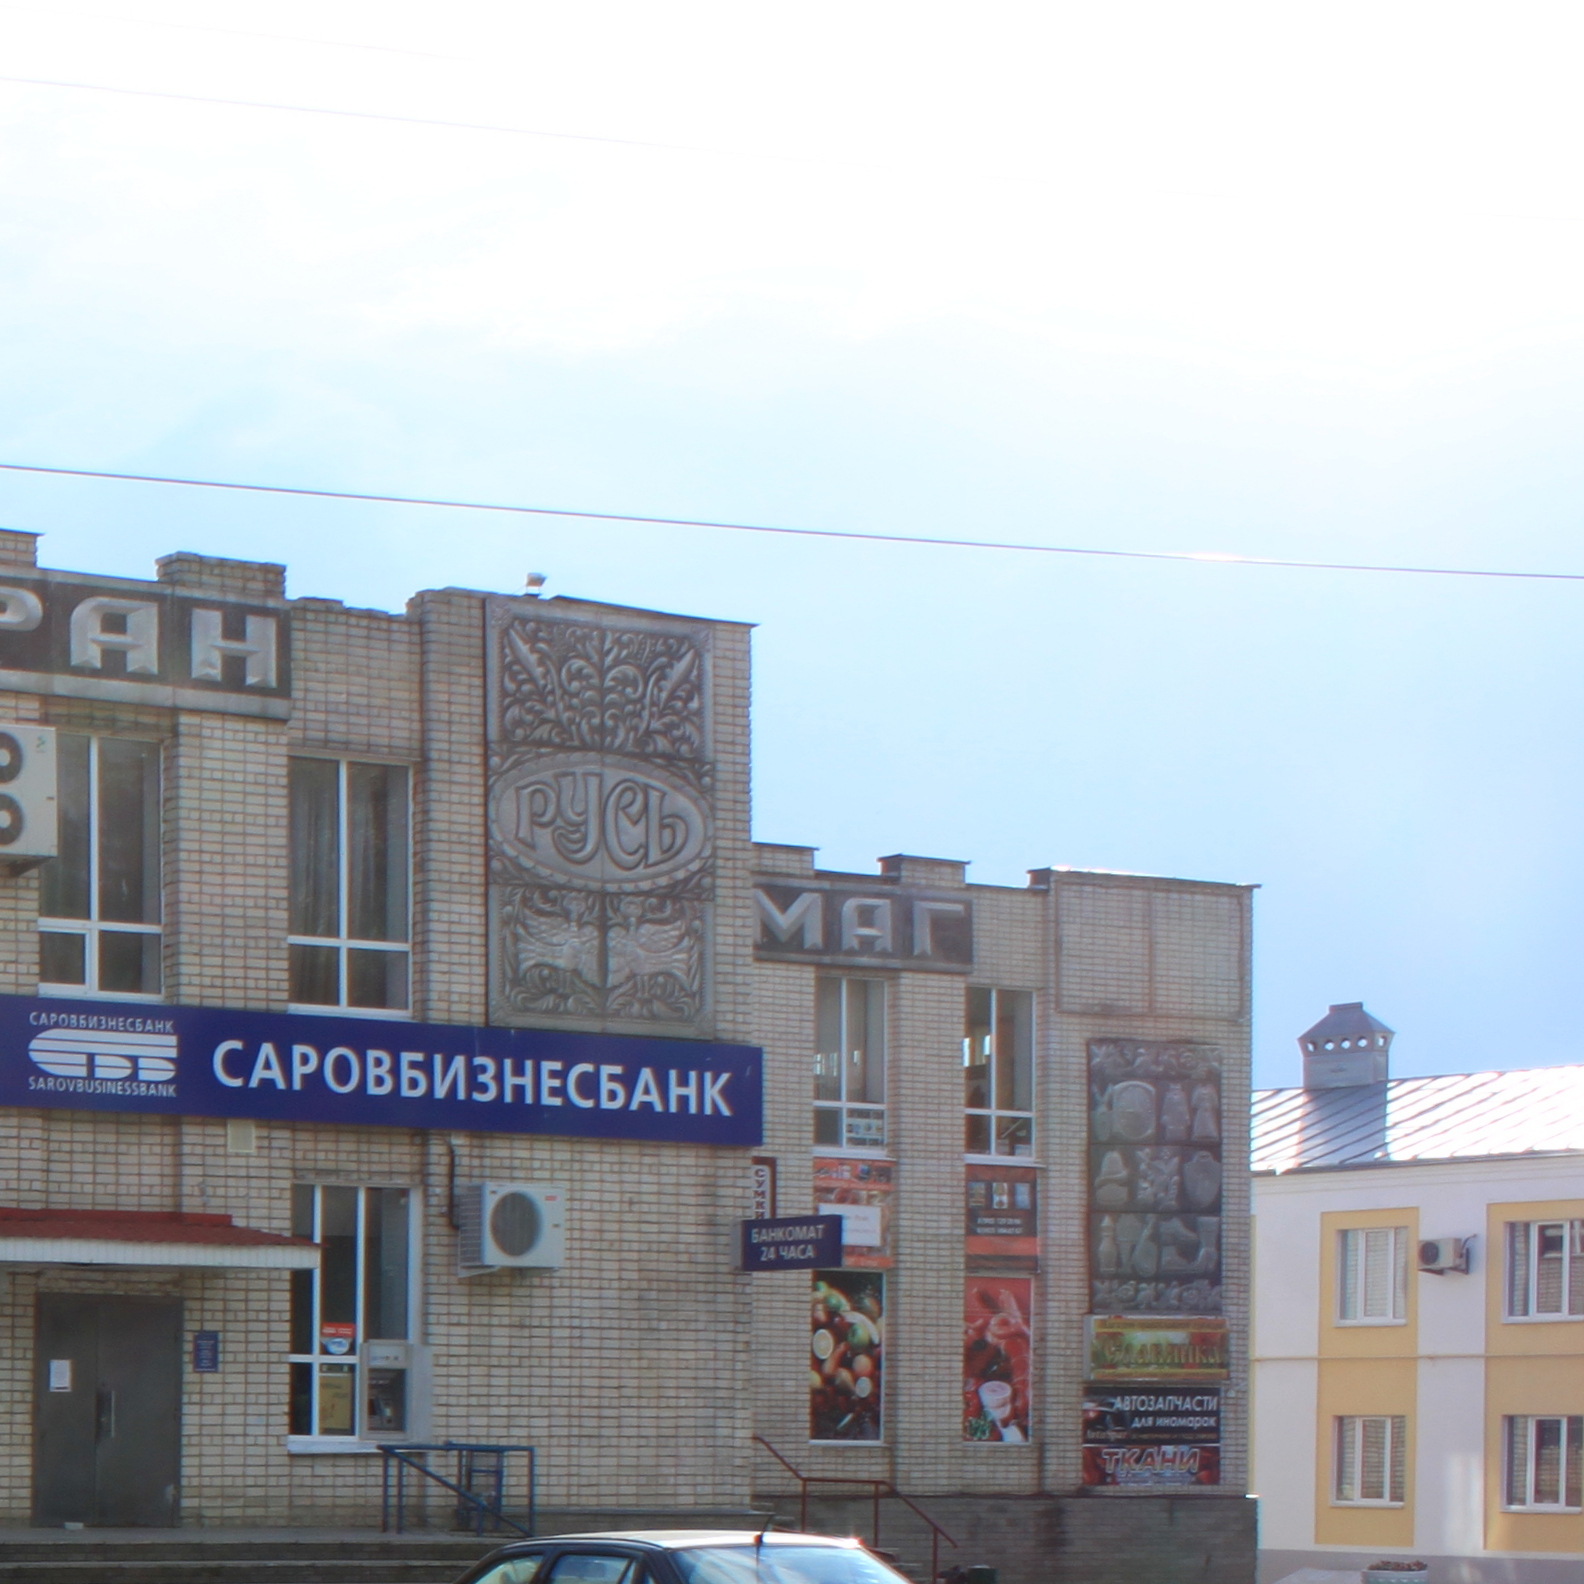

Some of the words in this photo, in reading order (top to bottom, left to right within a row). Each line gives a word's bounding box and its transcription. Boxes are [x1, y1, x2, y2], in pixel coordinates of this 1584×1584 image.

[514, 772, 689, 870] РУСЬ
[29, 1011, 174, 1034] САРОВБИЗНЕСБАНК
[28, 1076, 177, 1098] SAROVBUSINESSBANK
[212, 1039, 734, 1118] САРОВБИЗНЕСБАНК
[751, 1224, 826, 1243] БАНКОМАТ
[760, 1246, 776, 1261] 24
[779, 1244, 815, 1260] ЧАСА
[1112, 1395, 1218, 1411] АВТОЗАПЧАСТИ
[1132, 1416, 1152, 1428] для
[1155, 1416, 1218, 1430] иномарок
[1102, 1448, 1200, 1474] ТКАНИ
